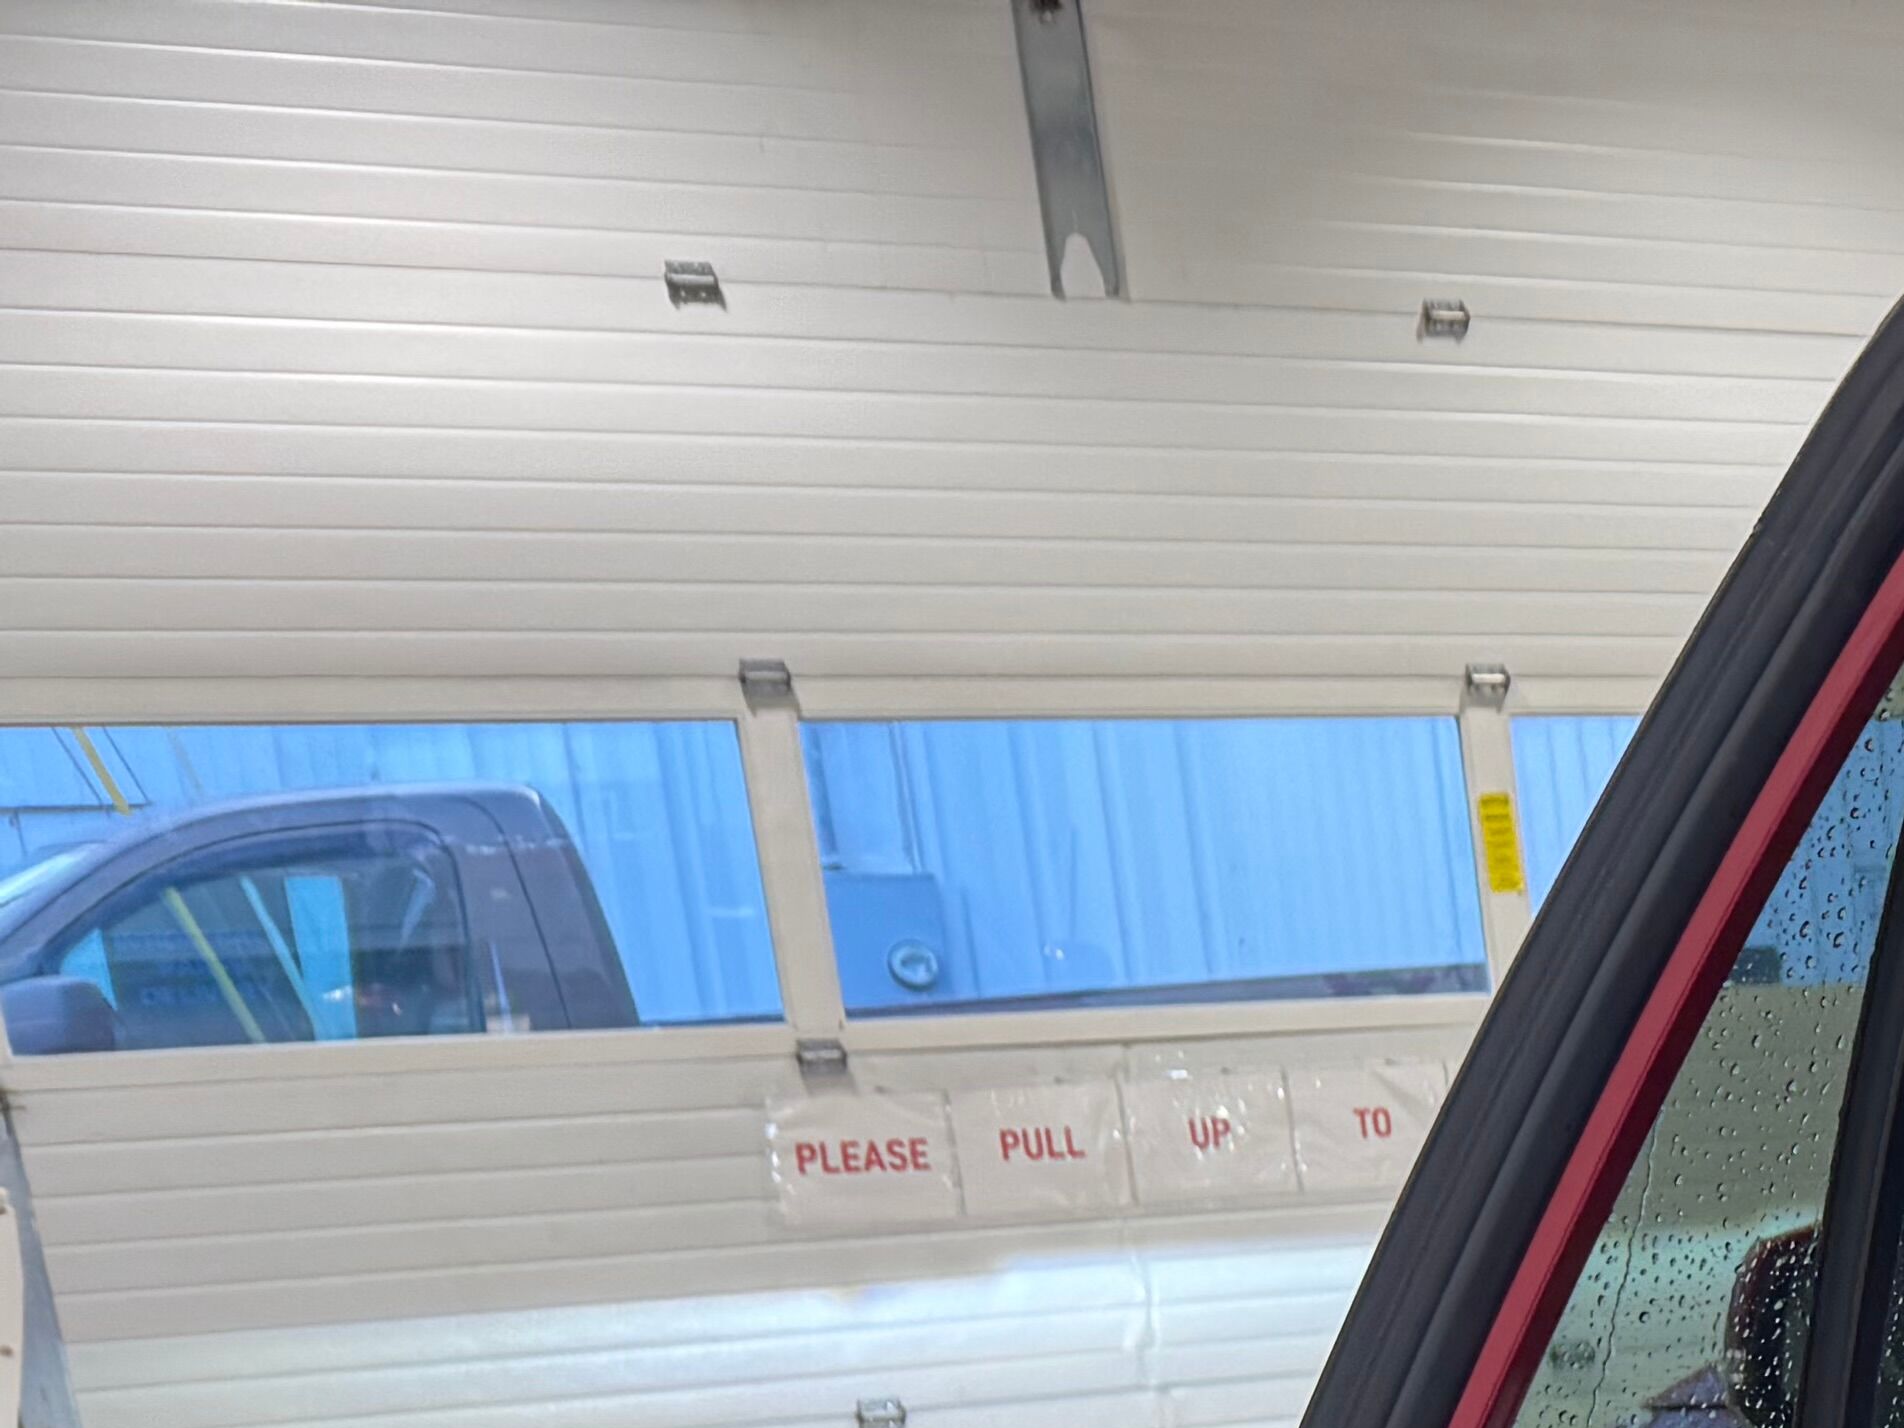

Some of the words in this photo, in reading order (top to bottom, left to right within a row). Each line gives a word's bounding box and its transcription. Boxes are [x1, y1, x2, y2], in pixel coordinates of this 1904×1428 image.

[794, 1138, 932, 1175] PLEASE
[999, 1125, 1086, 1162] PULL
[1187, 1117, 1231, 1150] UP
[1353, 1107, 1393, 1139] TO
